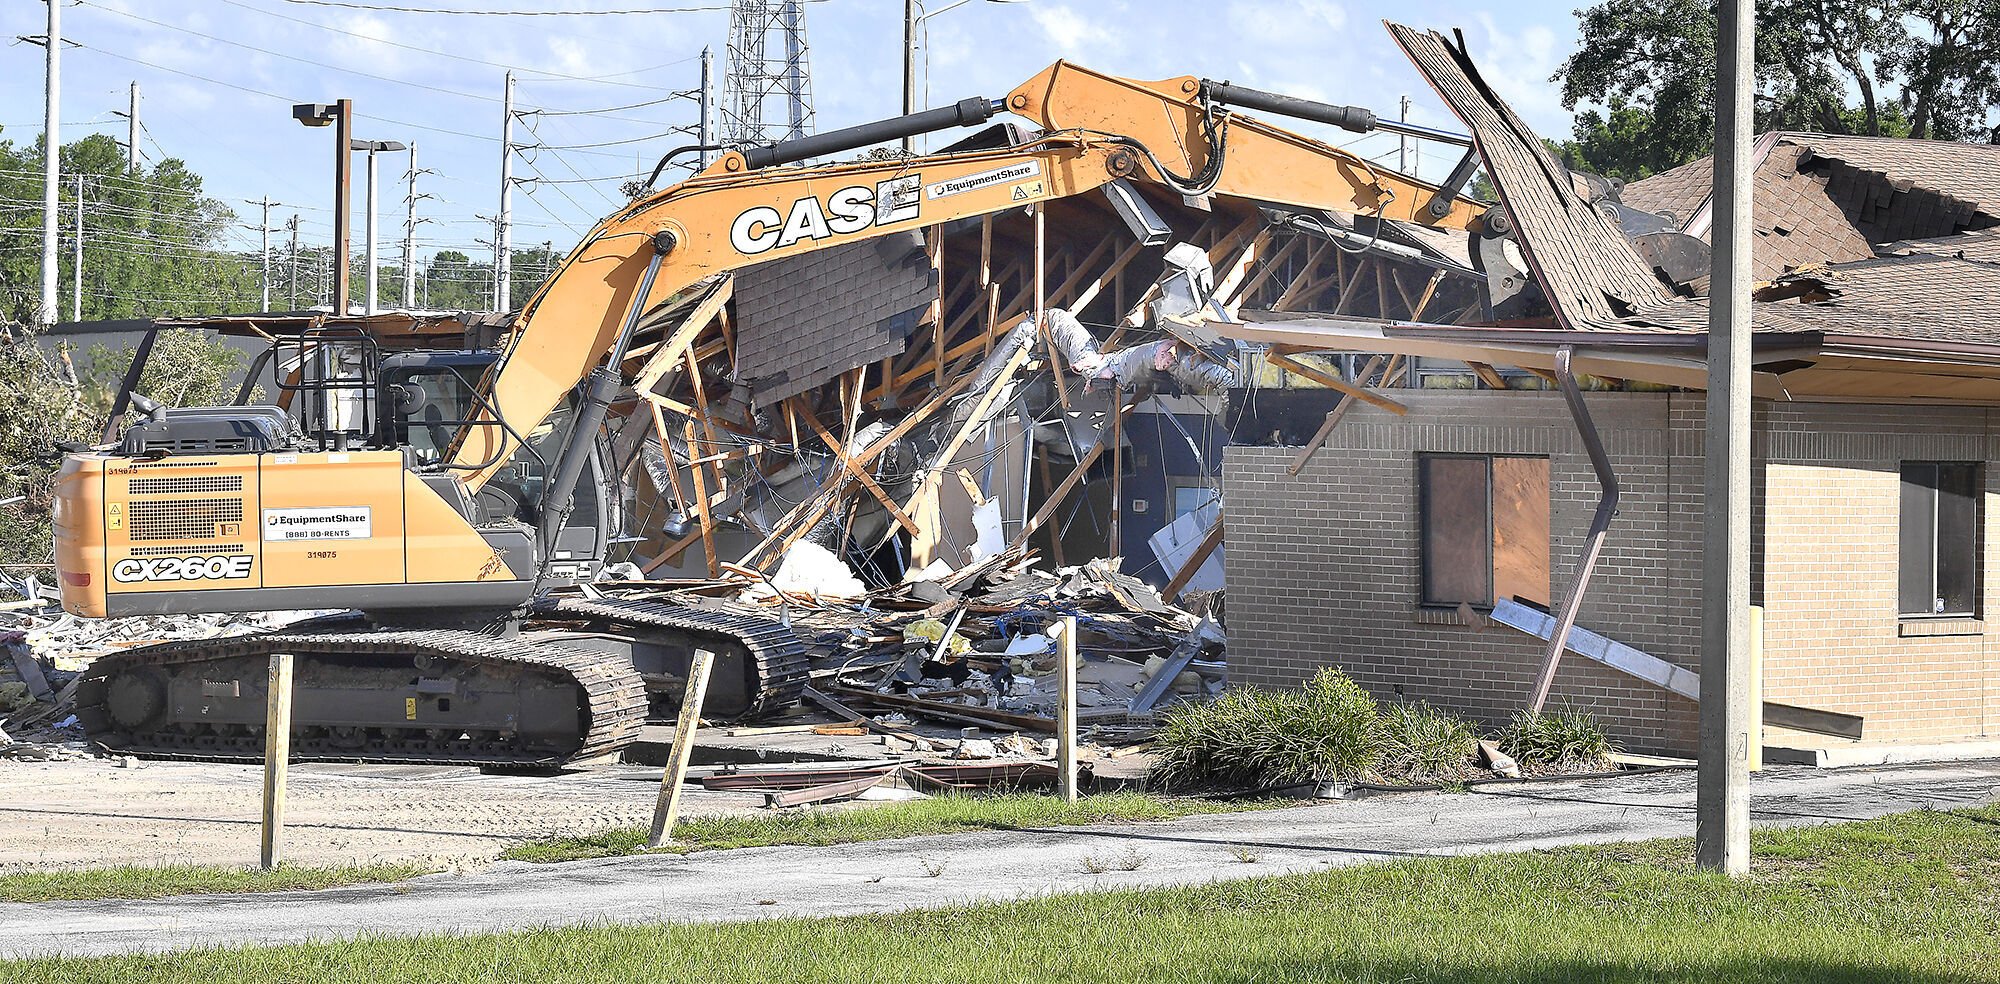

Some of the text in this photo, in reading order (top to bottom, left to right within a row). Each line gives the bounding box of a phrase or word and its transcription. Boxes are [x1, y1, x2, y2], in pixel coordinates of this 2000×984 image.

[946, 166, 1031, 192] EquipmentShare
[731, 173, 921, 255] CASE
[279, 514, 366, 525] EquipmentShare
[307, 551, 337, 559] 319075
[113, 556, 254, 582] CX260E
